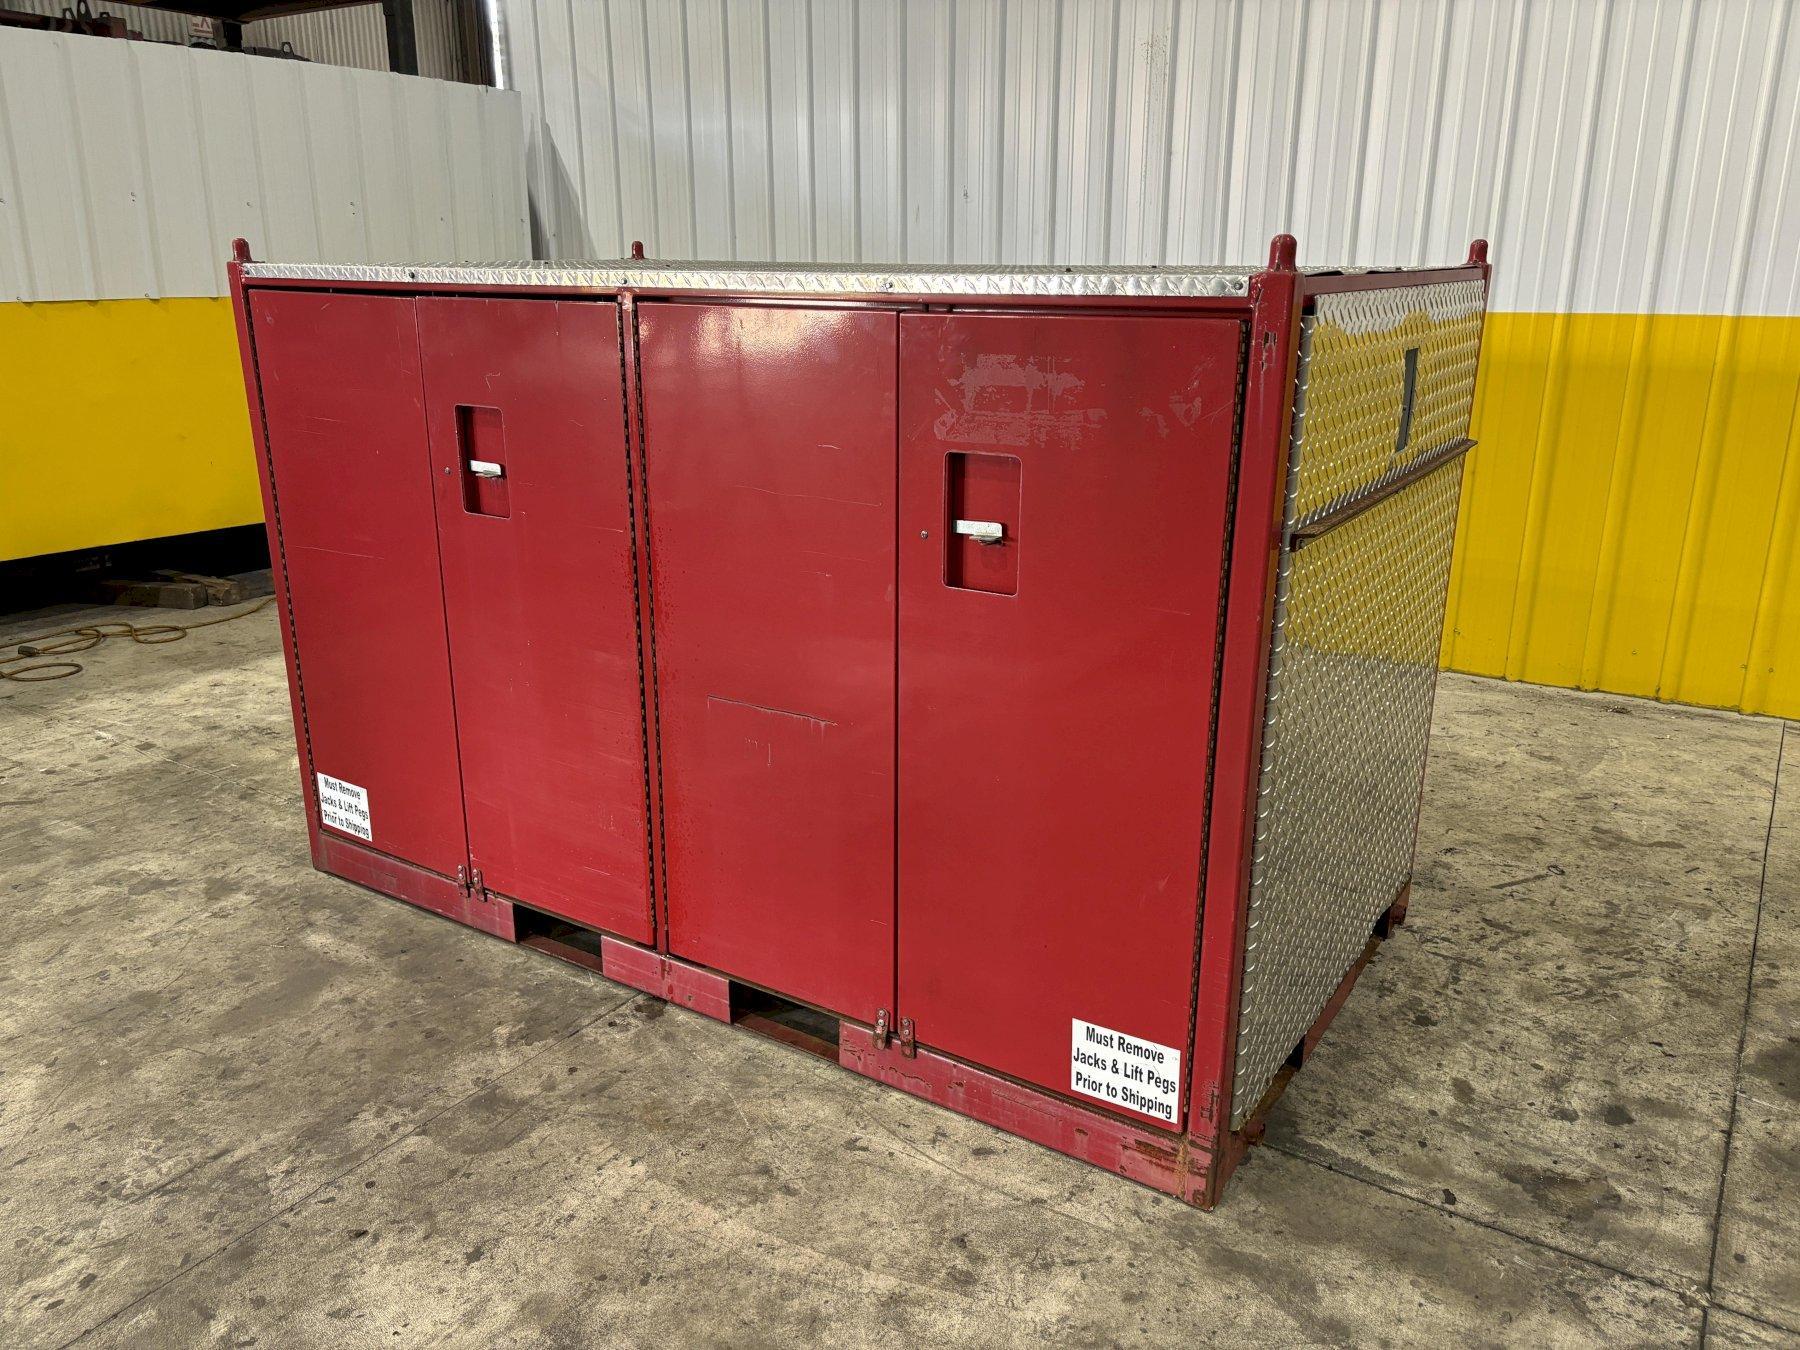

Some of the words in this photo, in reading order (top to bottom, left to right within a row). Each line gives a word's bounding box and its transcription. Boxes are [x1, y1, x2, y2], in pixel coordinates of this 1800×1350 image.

[324, 777, 337, 791] Must
[339, 782, 360, 799] Remove
[321, 793, 337, 807] Jacks
[338, 799, 343, 809] &
[344, 800, 353, 814] Lift
[355, 805, 368, 821] Pegs
[324, 809, 337, 823] Prior
[338, 815, 344, 827] to
[345, 817, 370, 839] Shipping
[1086, 1026, 1114, 1048] Must
[1118, 1036, 1165, 1064] Remove
[1073, 1048, 1107, 1071] Jacks
[1111, 1059, 1119, 1075] &
[1123, 1062, 1143, 1083] Lift
[1147, 1070, 1176, 1094] Pegs
[1075, 1071, 1102, 1093] Prior
[1106, 1082, 1117, 1098] to
[1121, 1086, 1172, 1120] Shipping
